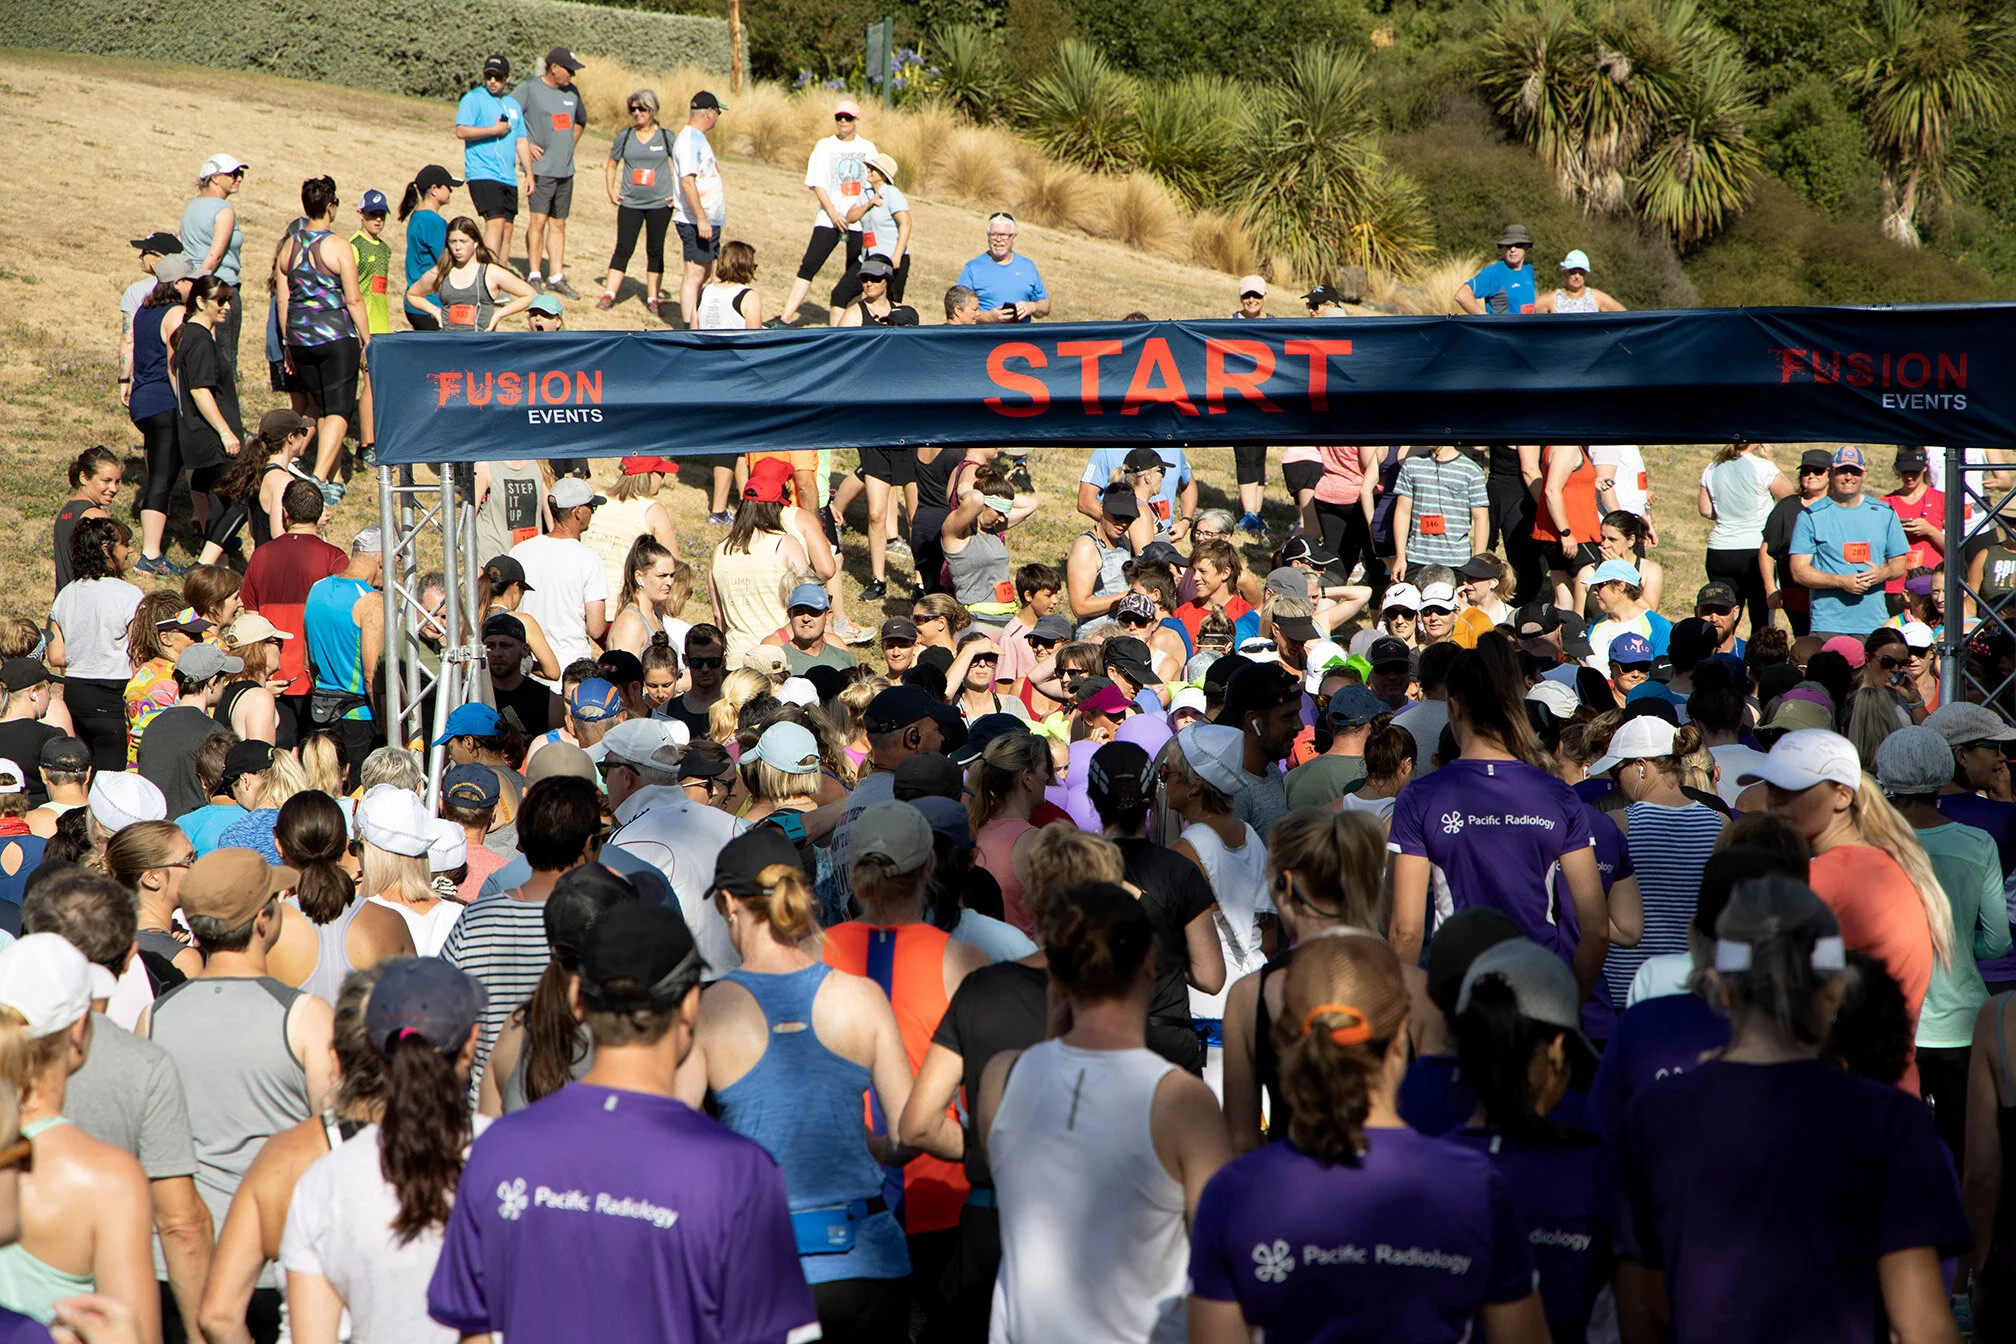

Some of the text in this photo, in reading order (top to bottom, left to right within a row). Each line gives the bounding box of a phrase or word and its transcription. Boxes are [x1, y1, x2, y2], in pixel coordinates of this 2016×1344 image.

[1779, 348, 1968, 389] FUSION
[983, 337, 1353, 418] START
[433, 369, 602, 408] FUSION
[1882, 393, 1968, 411] EVENTS
[528, 409, 604, 424] EVENTS
[508, 483, 534, 494] STEP
[509, 496, 519, 507] IT
[509, 510, 522, 521] UP
[1994, 560, 2016, 573] BRI
[1468, 814, 1555, 830] Pacific Radiology
[1597, 861, 1615, 873] ology
[534, 1185, 679, 1229] Pacific Radiology
[1528, 1228, 1592, 1251] diology
[1303, 1244, 1472, 1275] Pacific Radiology
